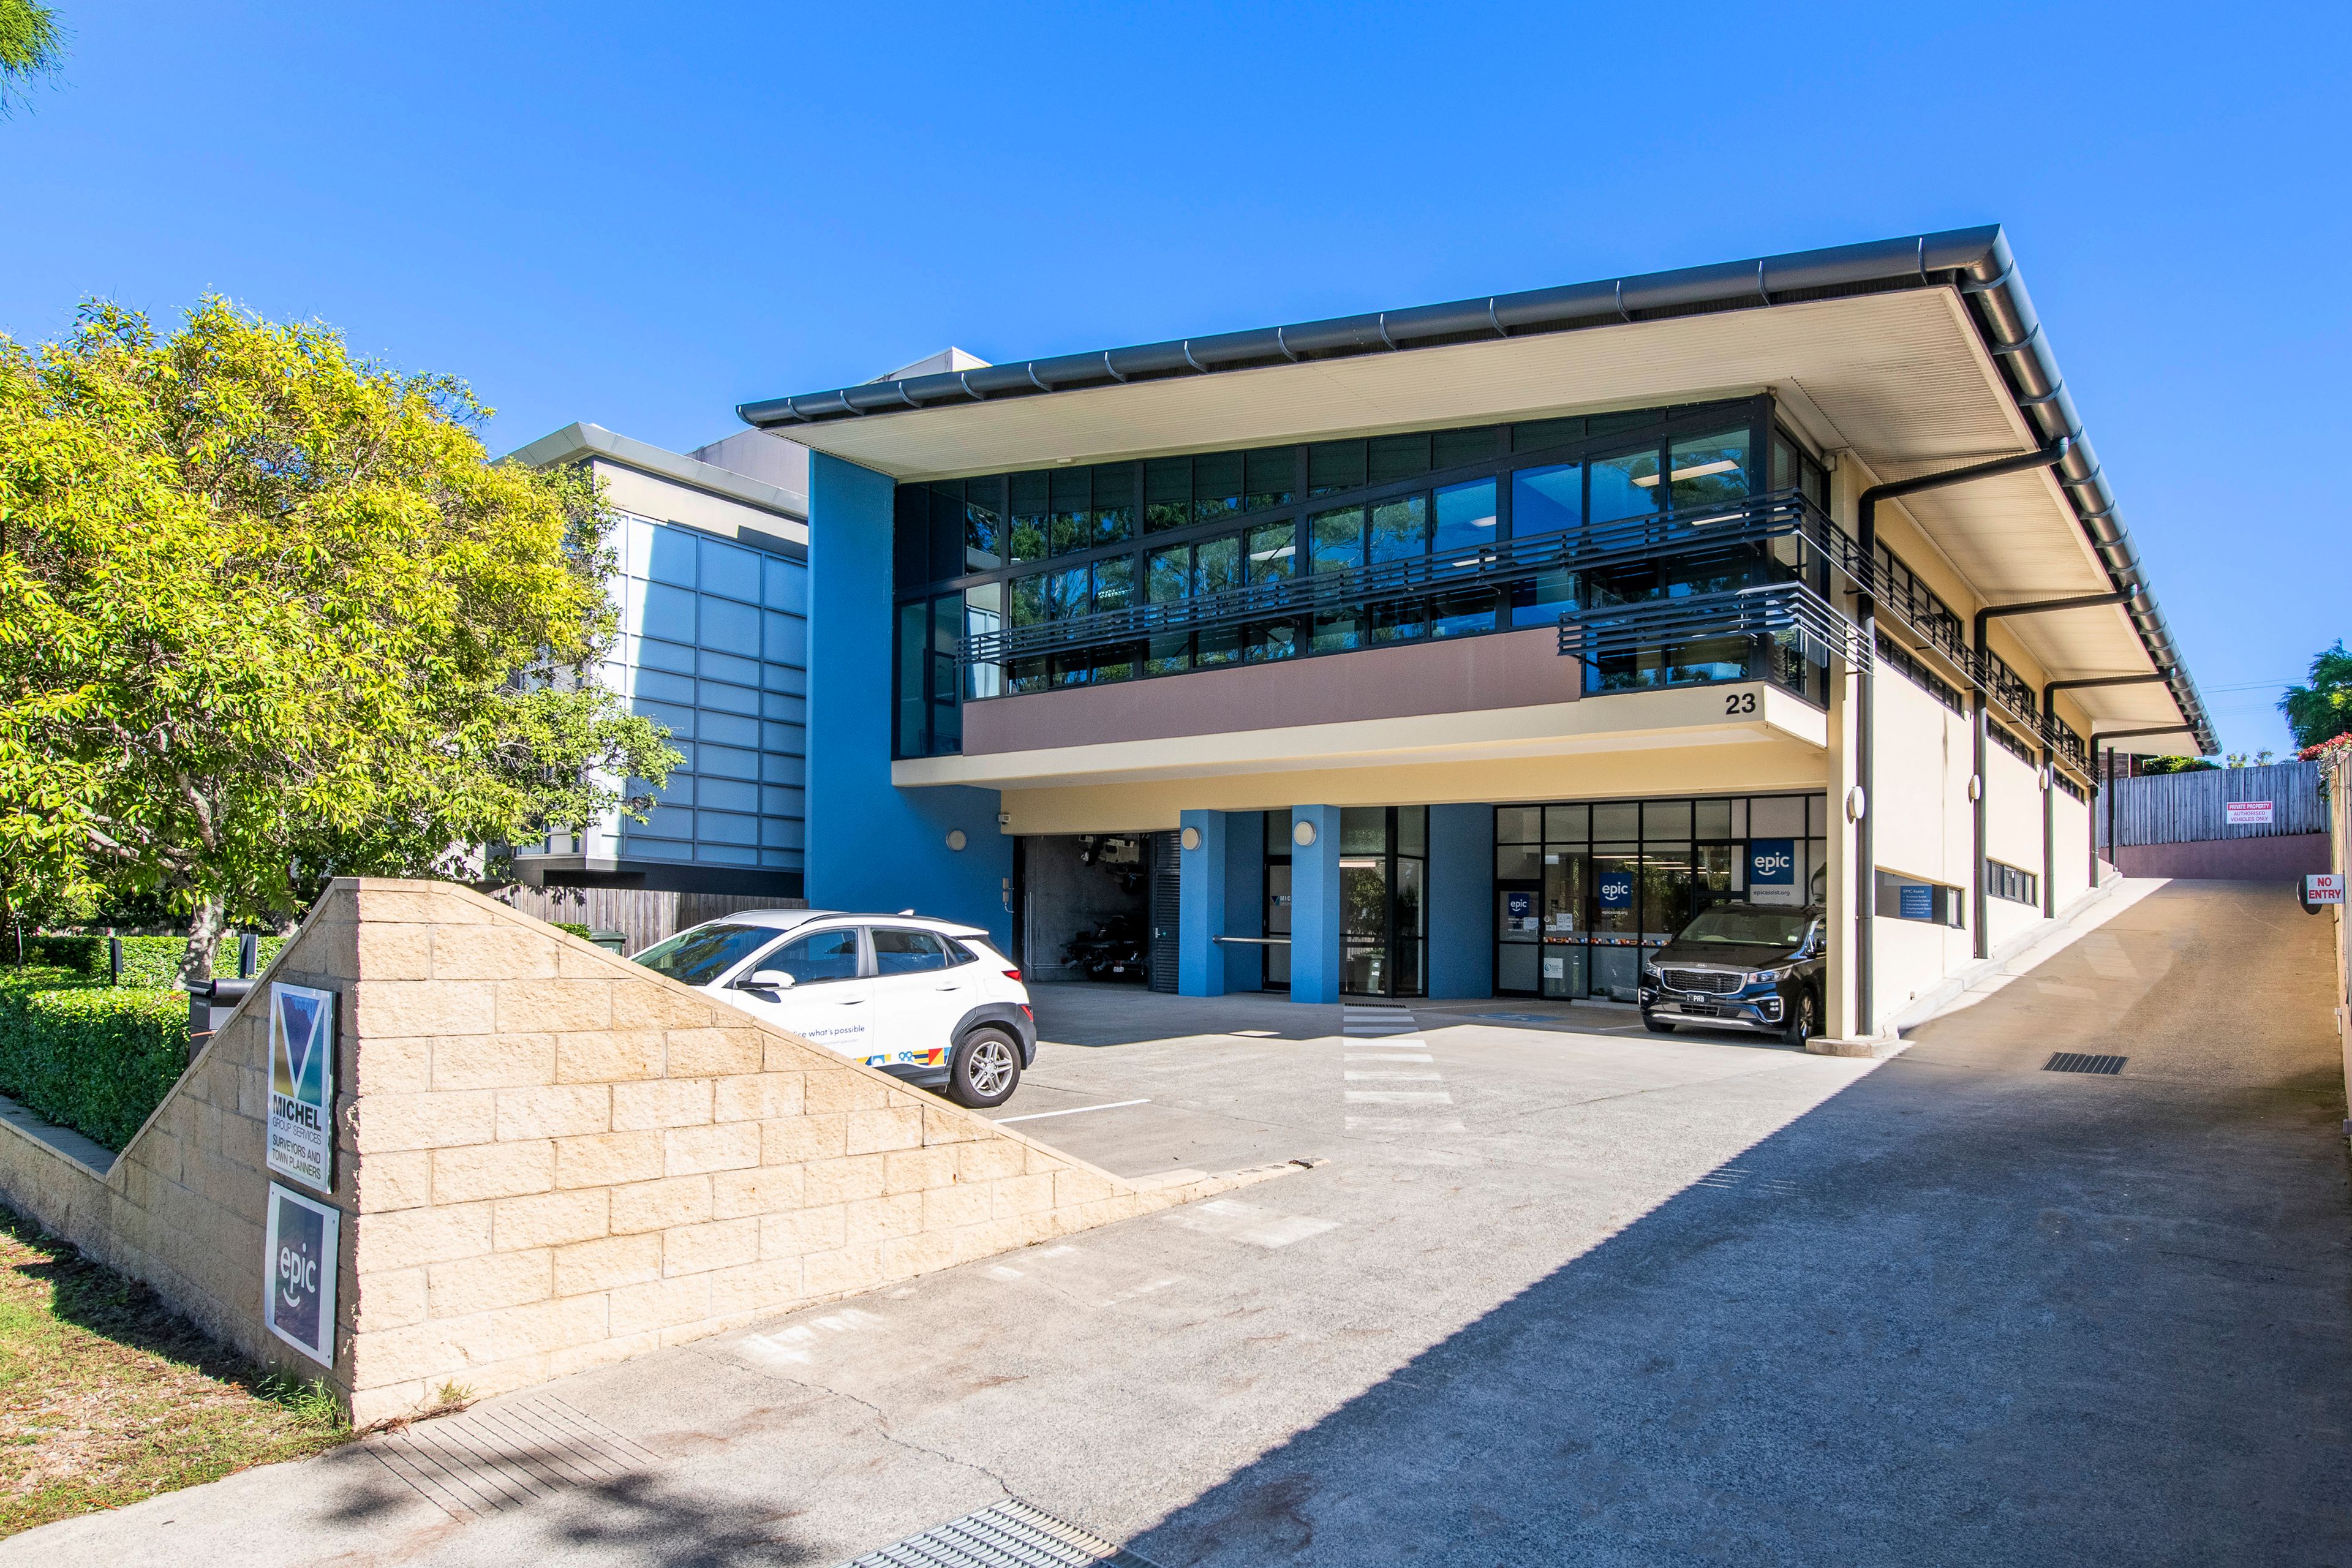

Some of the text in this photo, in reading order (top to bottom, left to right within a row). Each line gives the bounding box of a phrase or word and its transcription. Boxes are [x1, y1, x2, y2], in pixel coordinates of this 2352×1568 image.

[1726, 693, 1755, 715] 23
[1754, 852, 1790, 872] epic
[1602, 882, 1628, 897] epic
[2318, 877, 2332, 887] NO
[1510, 899, 1527, 910] epic
[2309, 889, 2342, 899] ENTRY
[809, 1028, 833, 1037] what's
[834, 1025, 865, 1036] possible
[273, 1095, 322, 1131] MICHEL
[273, 1117, 322, 1145] GROUP SERVICES
[273, 1134, 321, 1164] SURVEYORS AND
[273, 1148, 321, 1180] TOWN PLANNERS
[281, 1243, 317, 1294] epic
